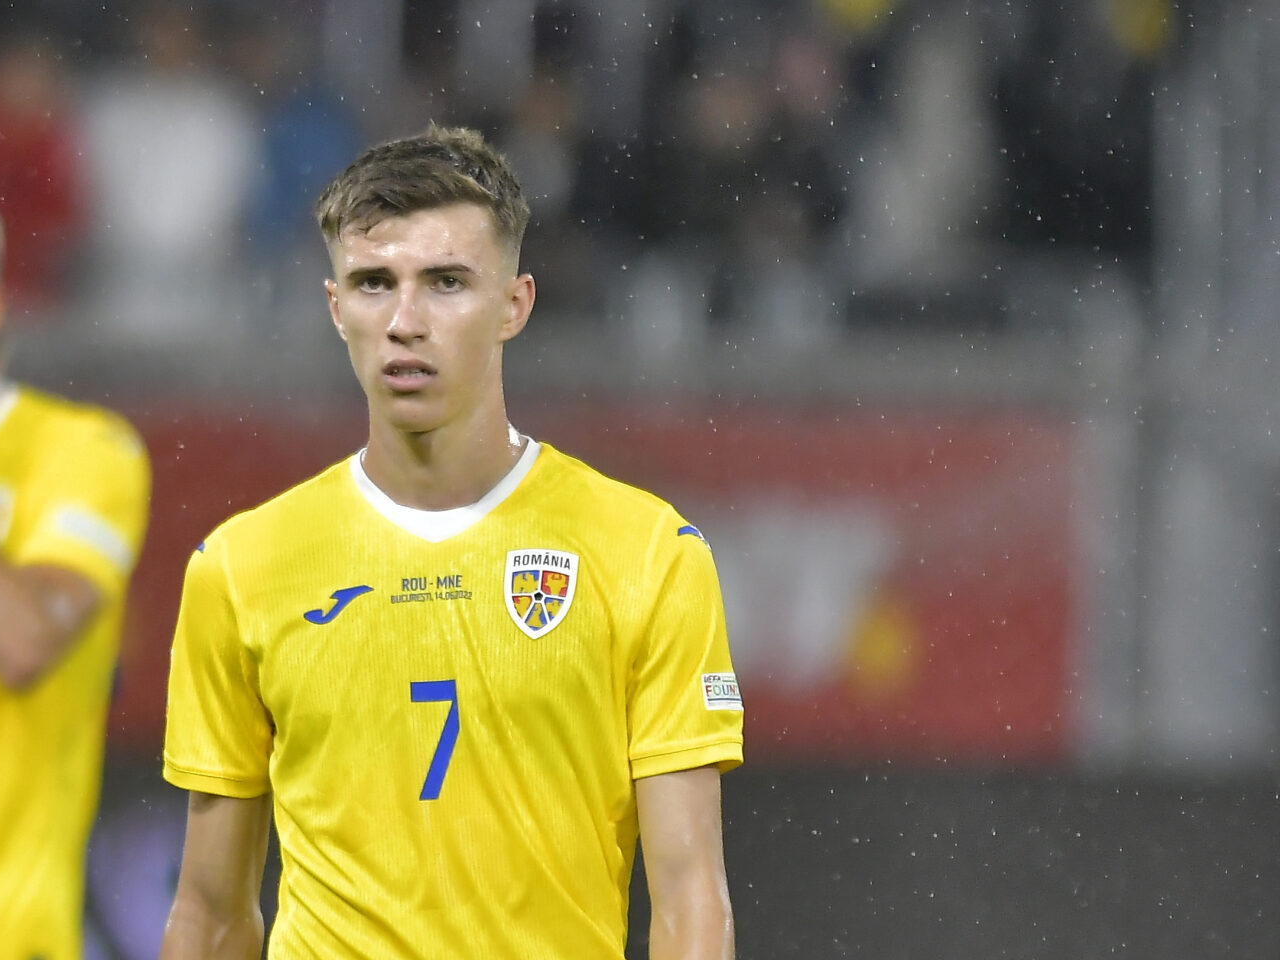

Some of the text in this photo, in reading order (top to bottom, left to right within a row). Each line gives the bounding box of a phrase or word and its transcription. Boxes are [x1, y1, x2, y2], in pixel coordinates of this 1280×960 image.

[402, 577, 427, 591] ROU
[436, 575, 463, 589] MNE
[410, 679, 460, 801] 7
